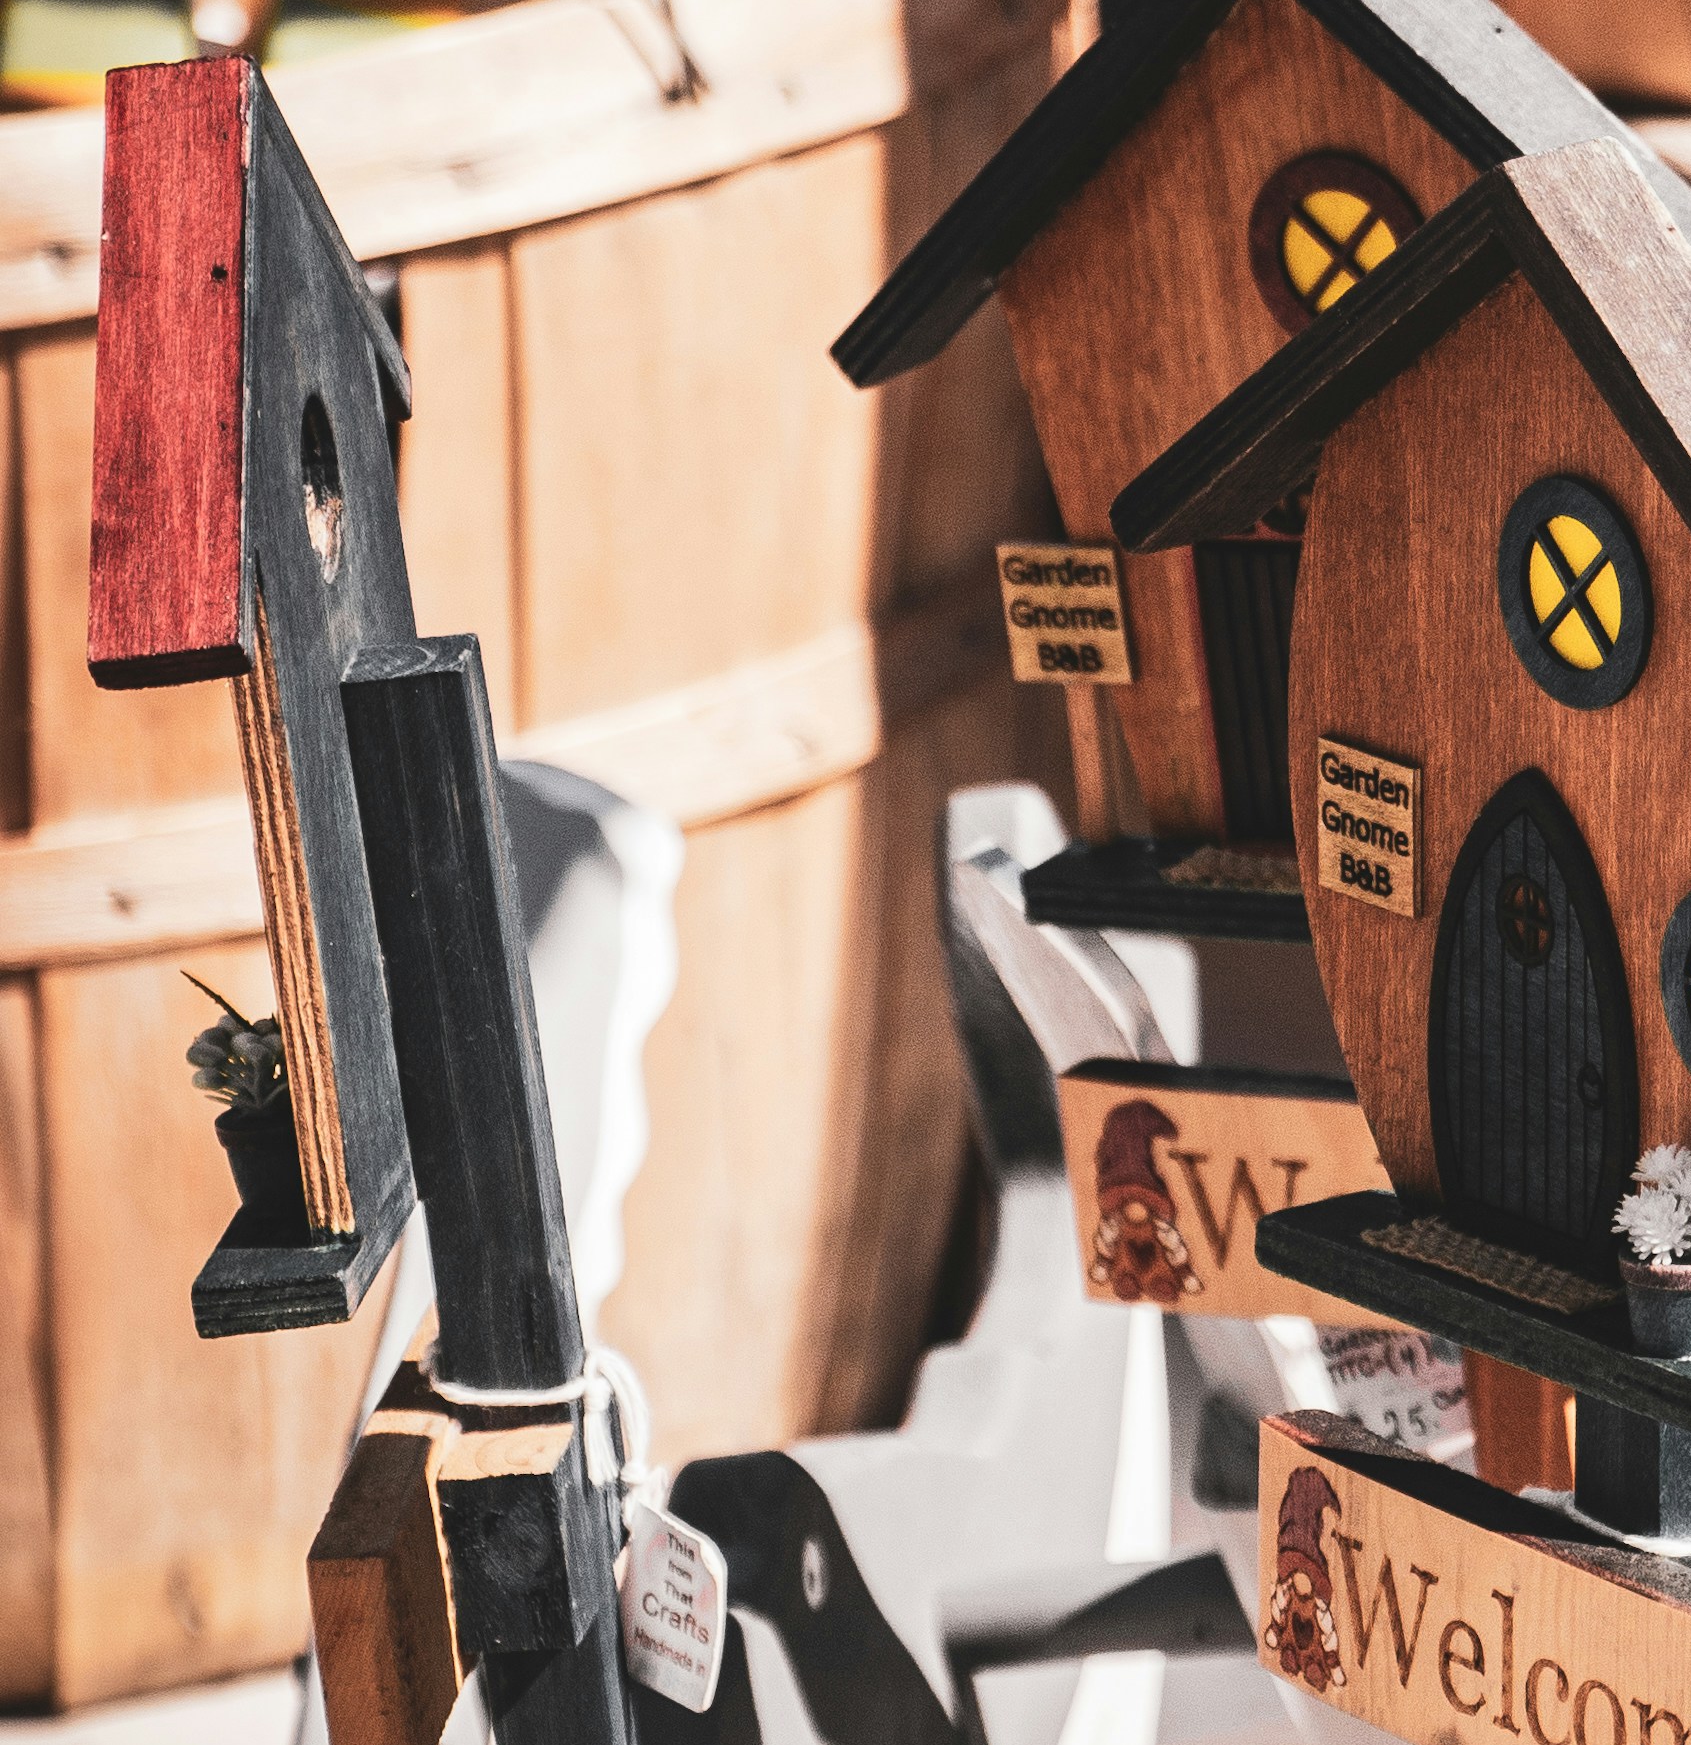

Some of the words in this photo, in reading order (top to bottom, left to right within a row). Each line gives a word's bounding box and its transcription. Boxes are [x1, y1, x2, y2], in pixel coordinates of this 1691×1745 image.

[1004, 556, 1111, 587] Garden
[1010, 598, 1118, 630] Gnome
[1038, 642, 1104, 672] B&B
[1320, 752, 1409, 810] Garden
[1322, 800, 1410, 857] Gnome
[1341, 852, 1393, 898] B&B
[667, 1532, 695, 1563] This
[664, 1579, 693, 1609] That
[642, 1592, 710, 1645] Crafts
